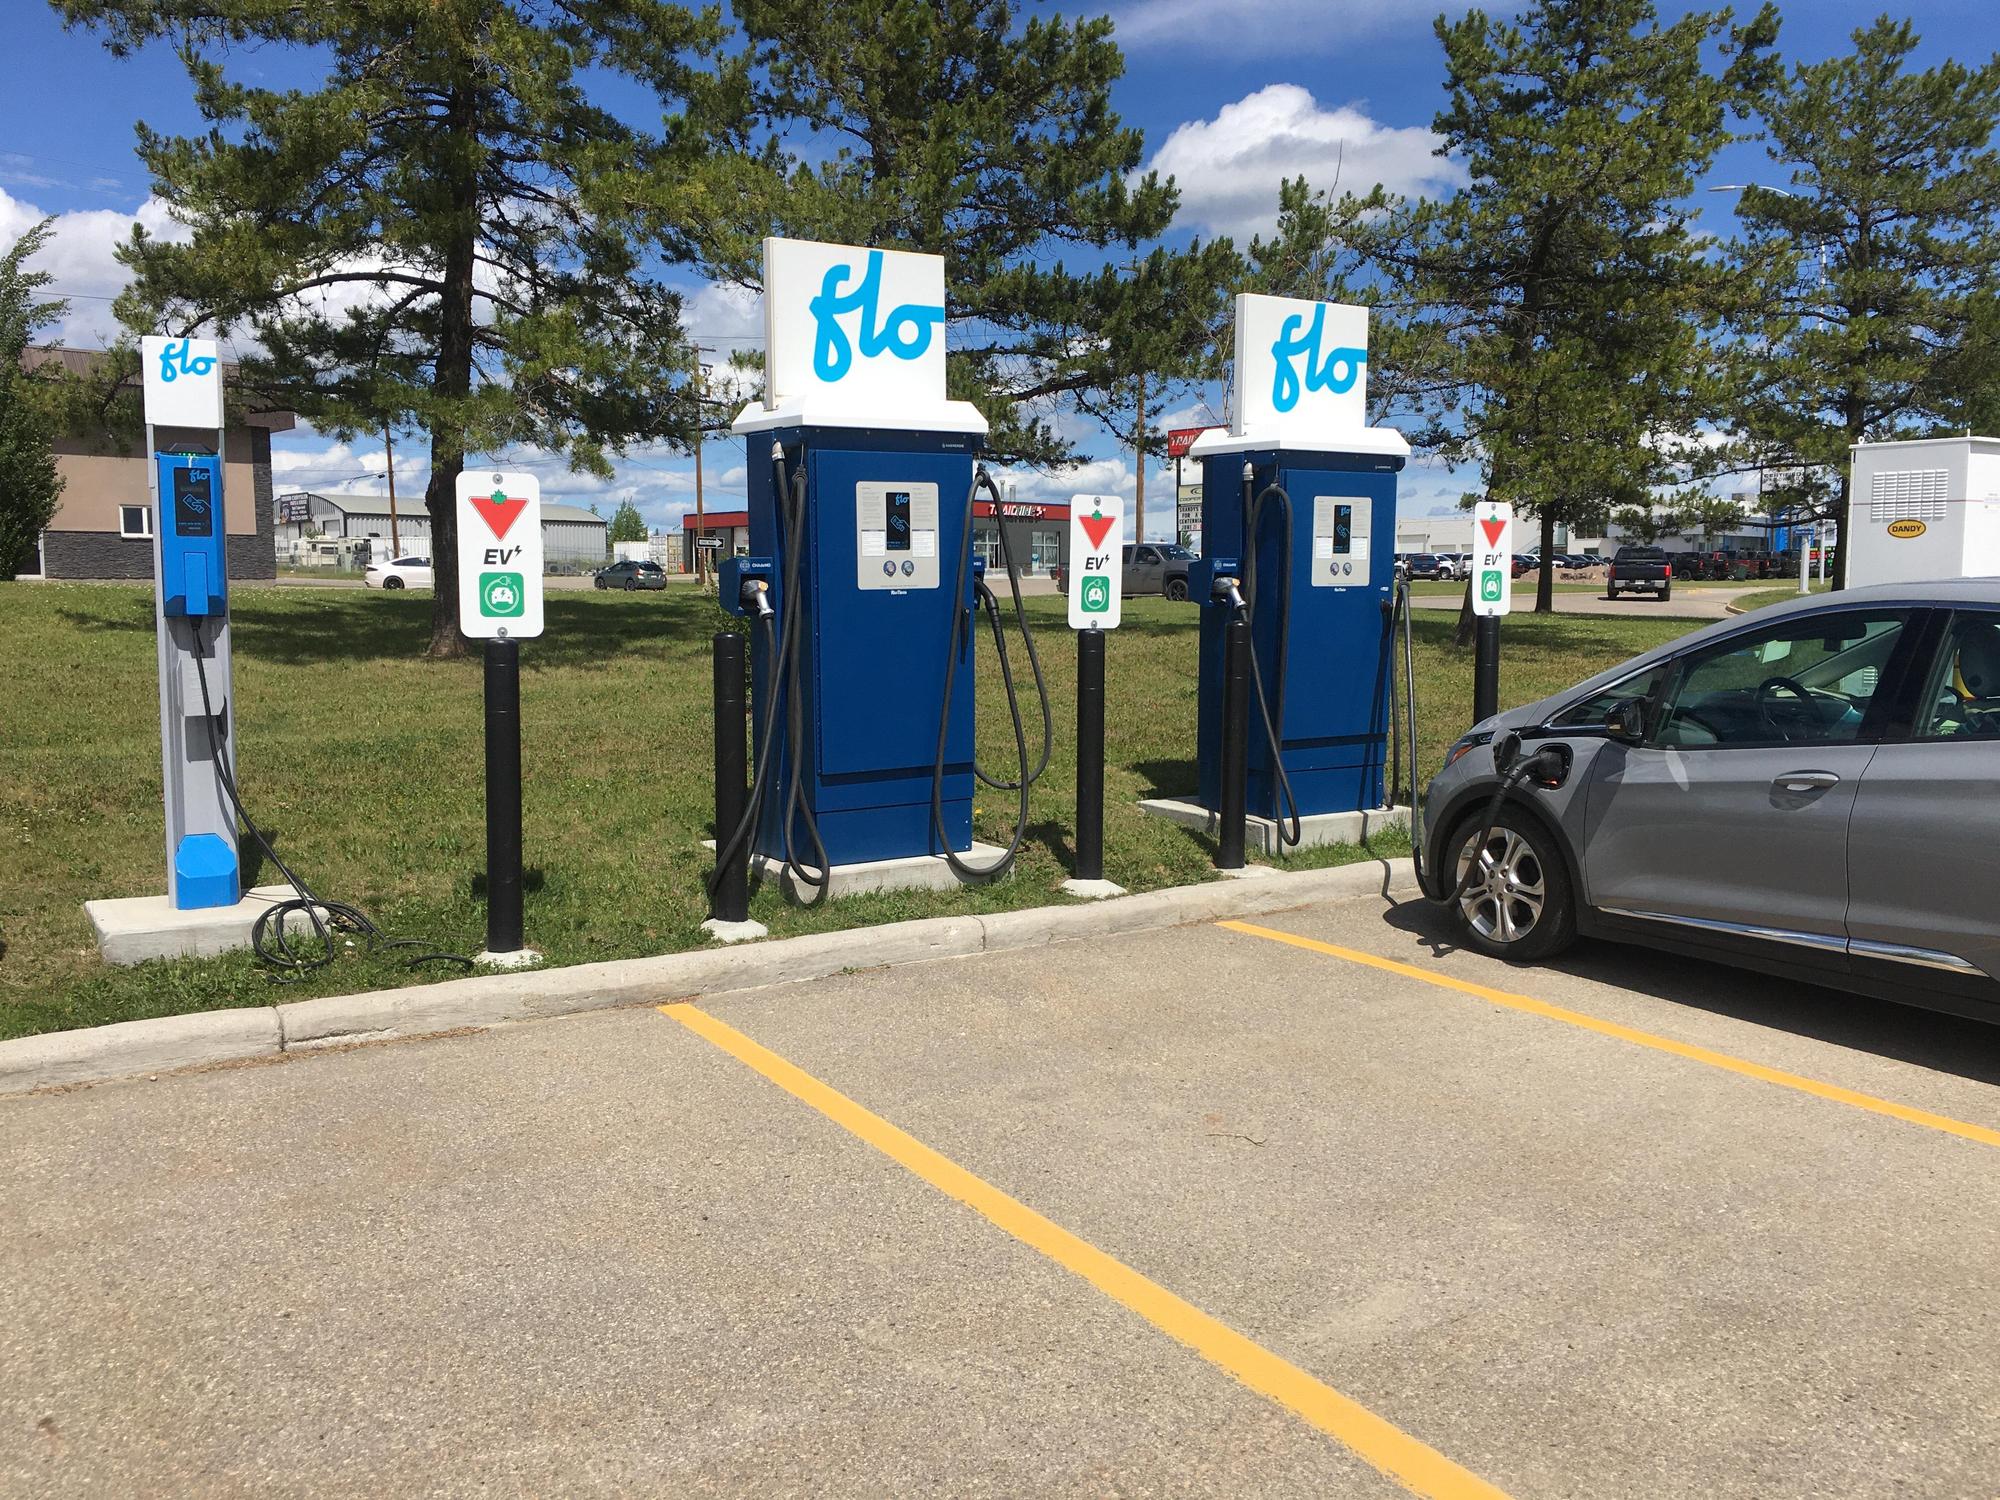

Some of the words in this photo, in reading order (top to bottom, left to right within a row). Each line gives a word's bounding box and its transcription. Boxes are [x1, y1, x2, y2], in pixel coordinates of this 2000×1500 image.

[809, 250, 945, 383] flo
[160, 338, 217, 383] flo
[1271, 303, 1367, 413] flo
[189, 469, 210, 483] flo
[895, 494, 910, 506] flo
[1891, 524, 1922, 533] DANDY
[483, 548, 514, 565] EV
[1085, 557, 1105, 570] EV
[1485, 554, 1499, 566] EV
